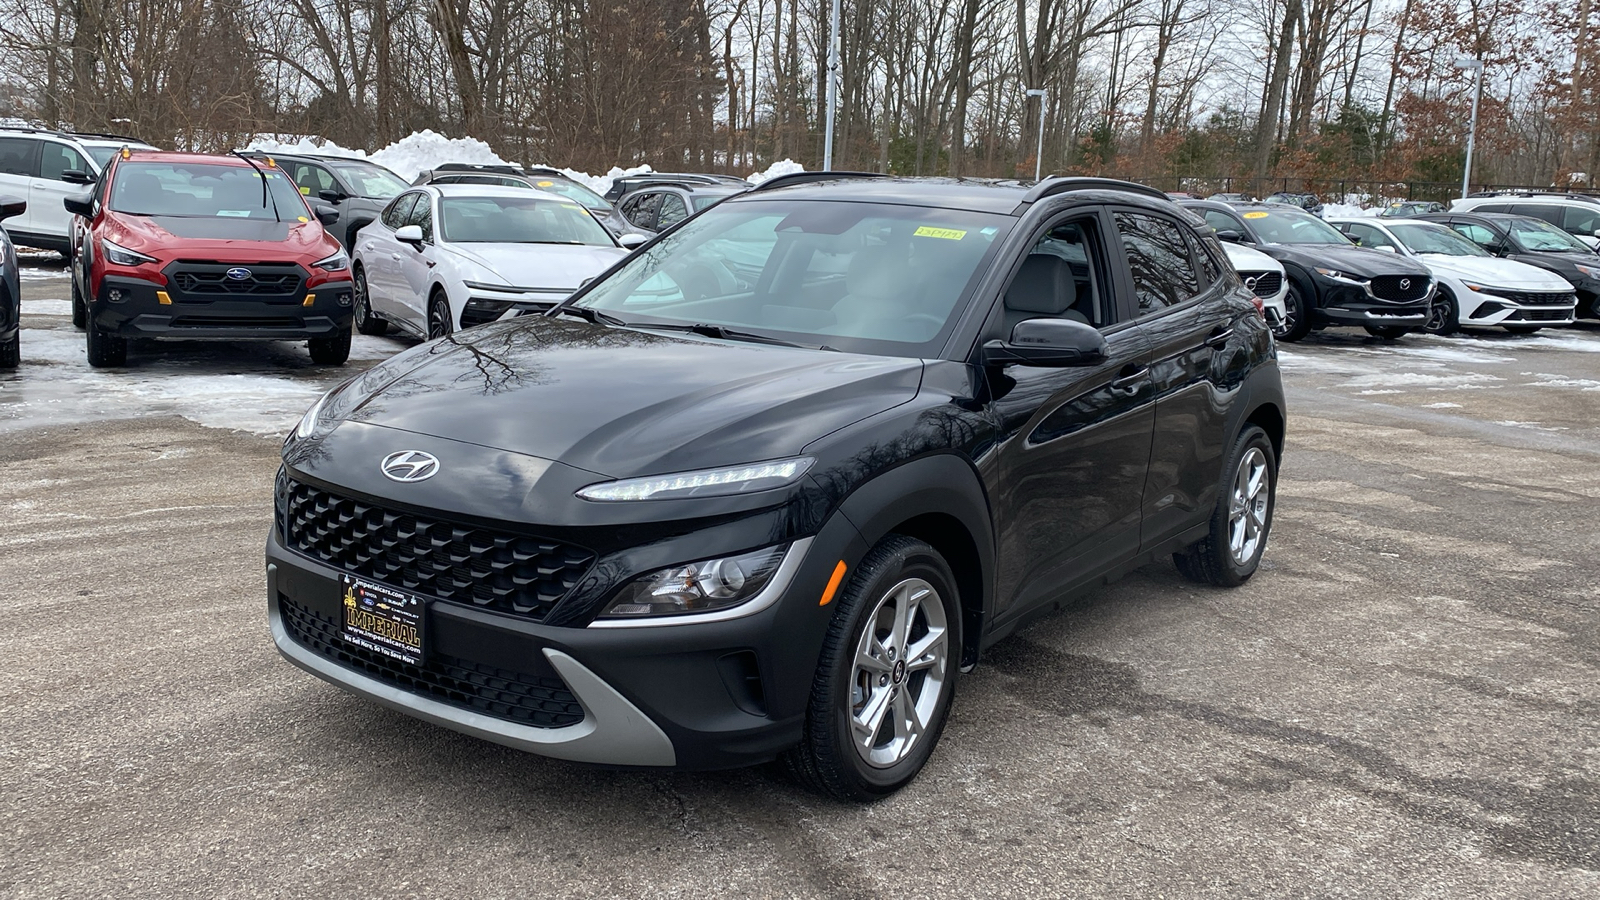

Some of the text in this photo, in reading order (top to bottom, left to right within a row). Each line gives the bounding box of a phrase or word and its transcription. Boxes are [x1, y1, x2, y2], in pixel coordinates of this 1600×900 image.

[391, 607, 419, 619] CHEVROLET
[346, 606, 421, 648] IMPERIAL
[347, 625, 421, 654] www.imperialcars.com
[381, 647, 390, 656] You
[390, 650, 402, 660] Save
[402, 654, 415, 665] More
